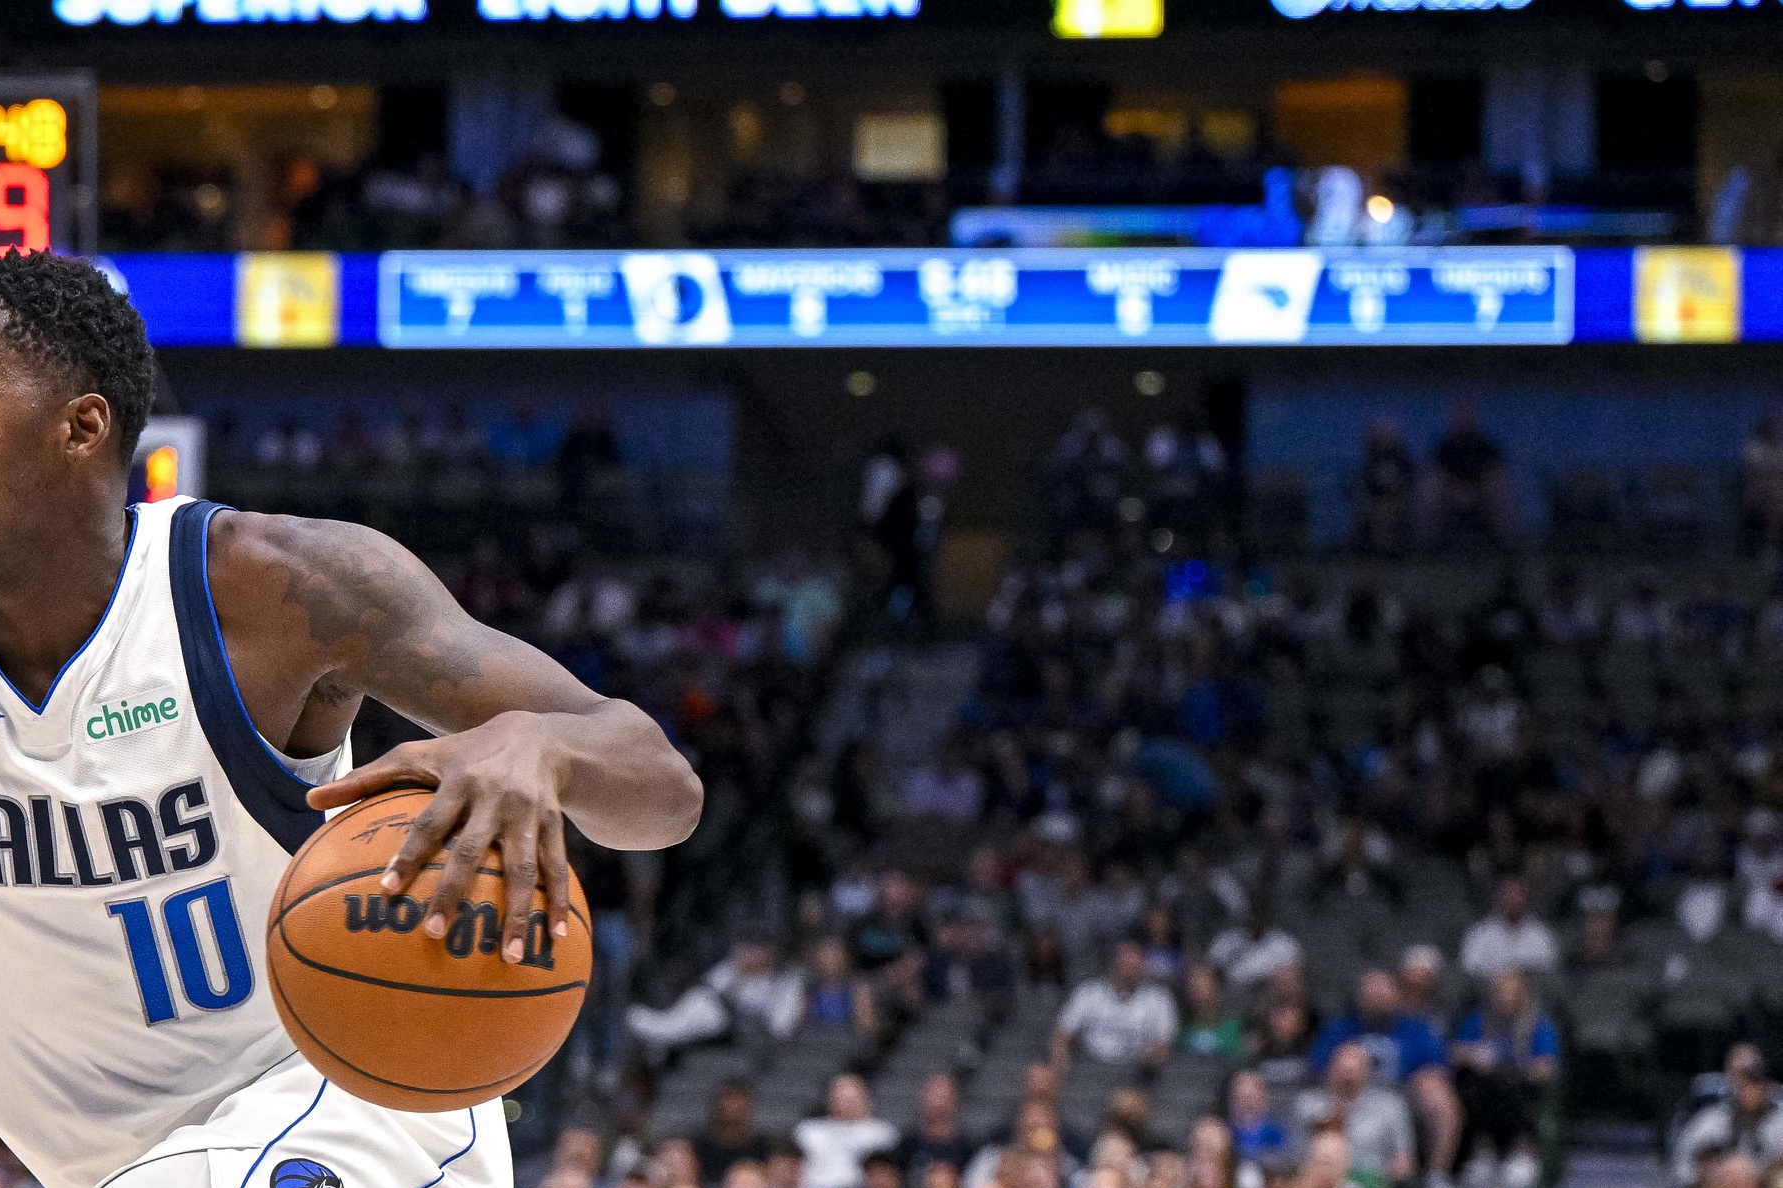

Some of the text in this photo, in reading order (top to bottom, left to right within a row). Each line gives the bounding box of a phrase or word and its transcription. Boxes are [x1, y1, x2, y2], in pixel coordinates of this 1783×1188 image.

[86, 696, 179, 740] chime
[104, 876, 256, 1027] 10
[344, 893, 556, 971] Wilon
